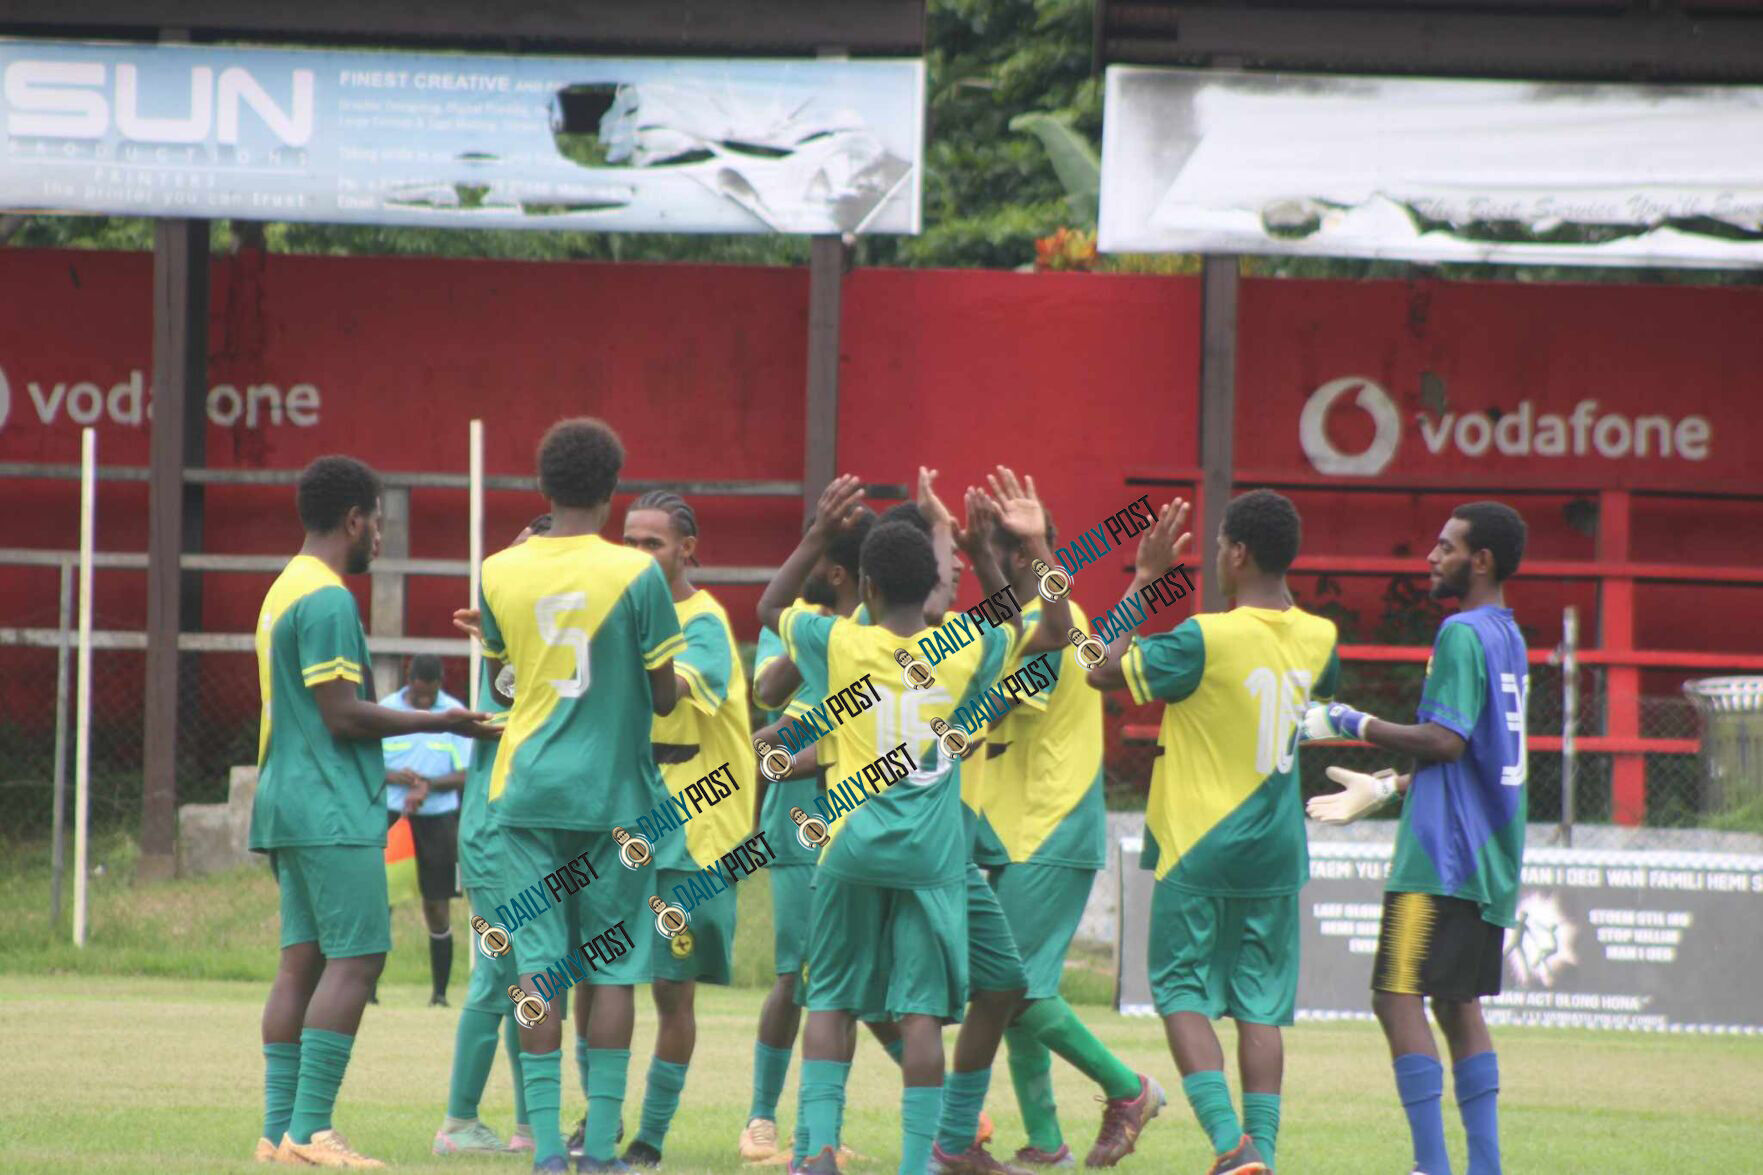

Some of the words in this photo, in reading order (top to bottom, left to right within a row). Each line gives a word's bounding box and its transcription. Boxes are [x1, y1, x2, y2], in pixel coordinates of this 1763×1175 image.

[4, 60, 314, 148] SUN
[340, 71, 408, 89] FINEST
[414, 73, 509, 91] CREATIVE
[27, 370, 320, 427] vodone
[1417, 399, 1711, 460] vodafone
[536, 592, 590, 698] 5
[1606, 868, 1646, 888] WAN
[1649, 870, 1704, 891] FAMILI
[1707, 873, 1748, 892] HEMI
[1597, 927, 1633, 943] STOP
